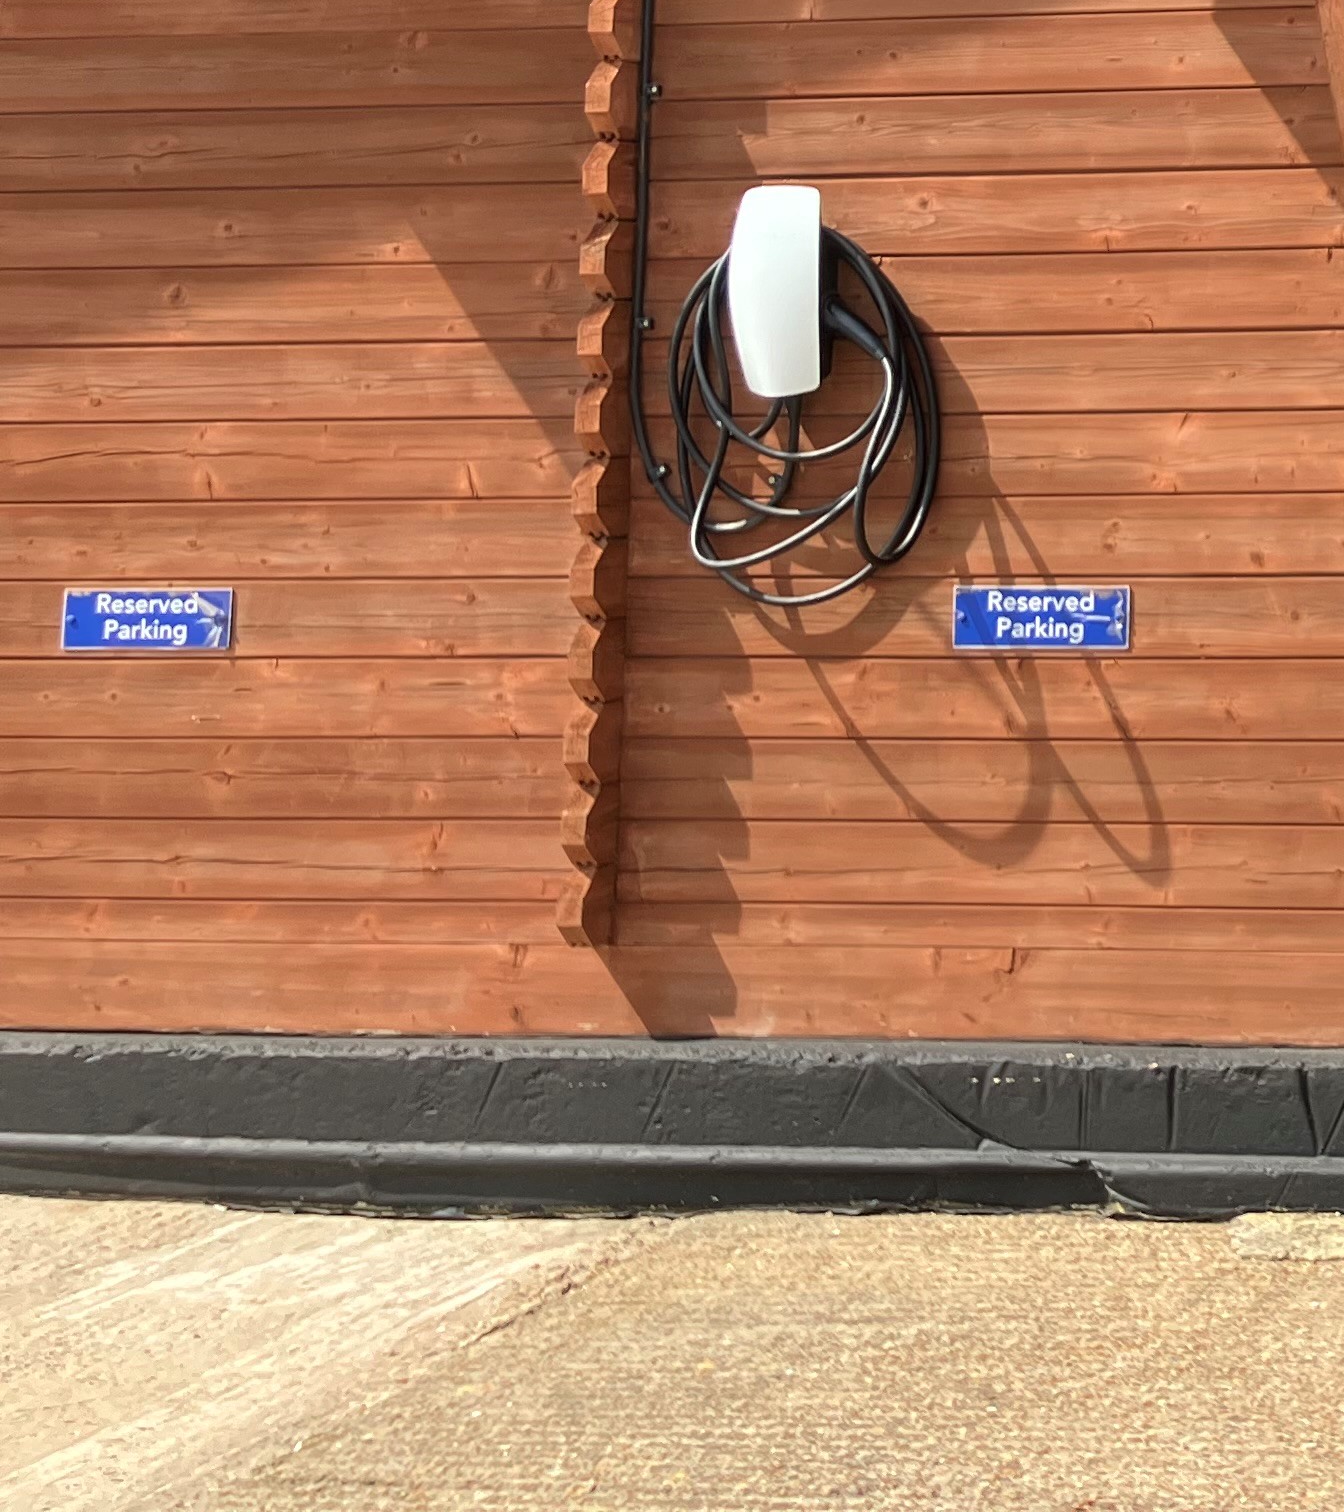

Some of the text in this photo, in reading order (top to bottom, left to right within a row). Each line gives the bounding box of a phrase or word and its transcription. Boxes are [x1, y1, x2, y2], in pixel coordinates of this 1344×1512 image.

[96, 592, 199, 615] Reserved
[987, 590, 1095, 613] Reserved
[102, 618, 188, 646] Parking
[996, 615, 1085, 645] Parking
